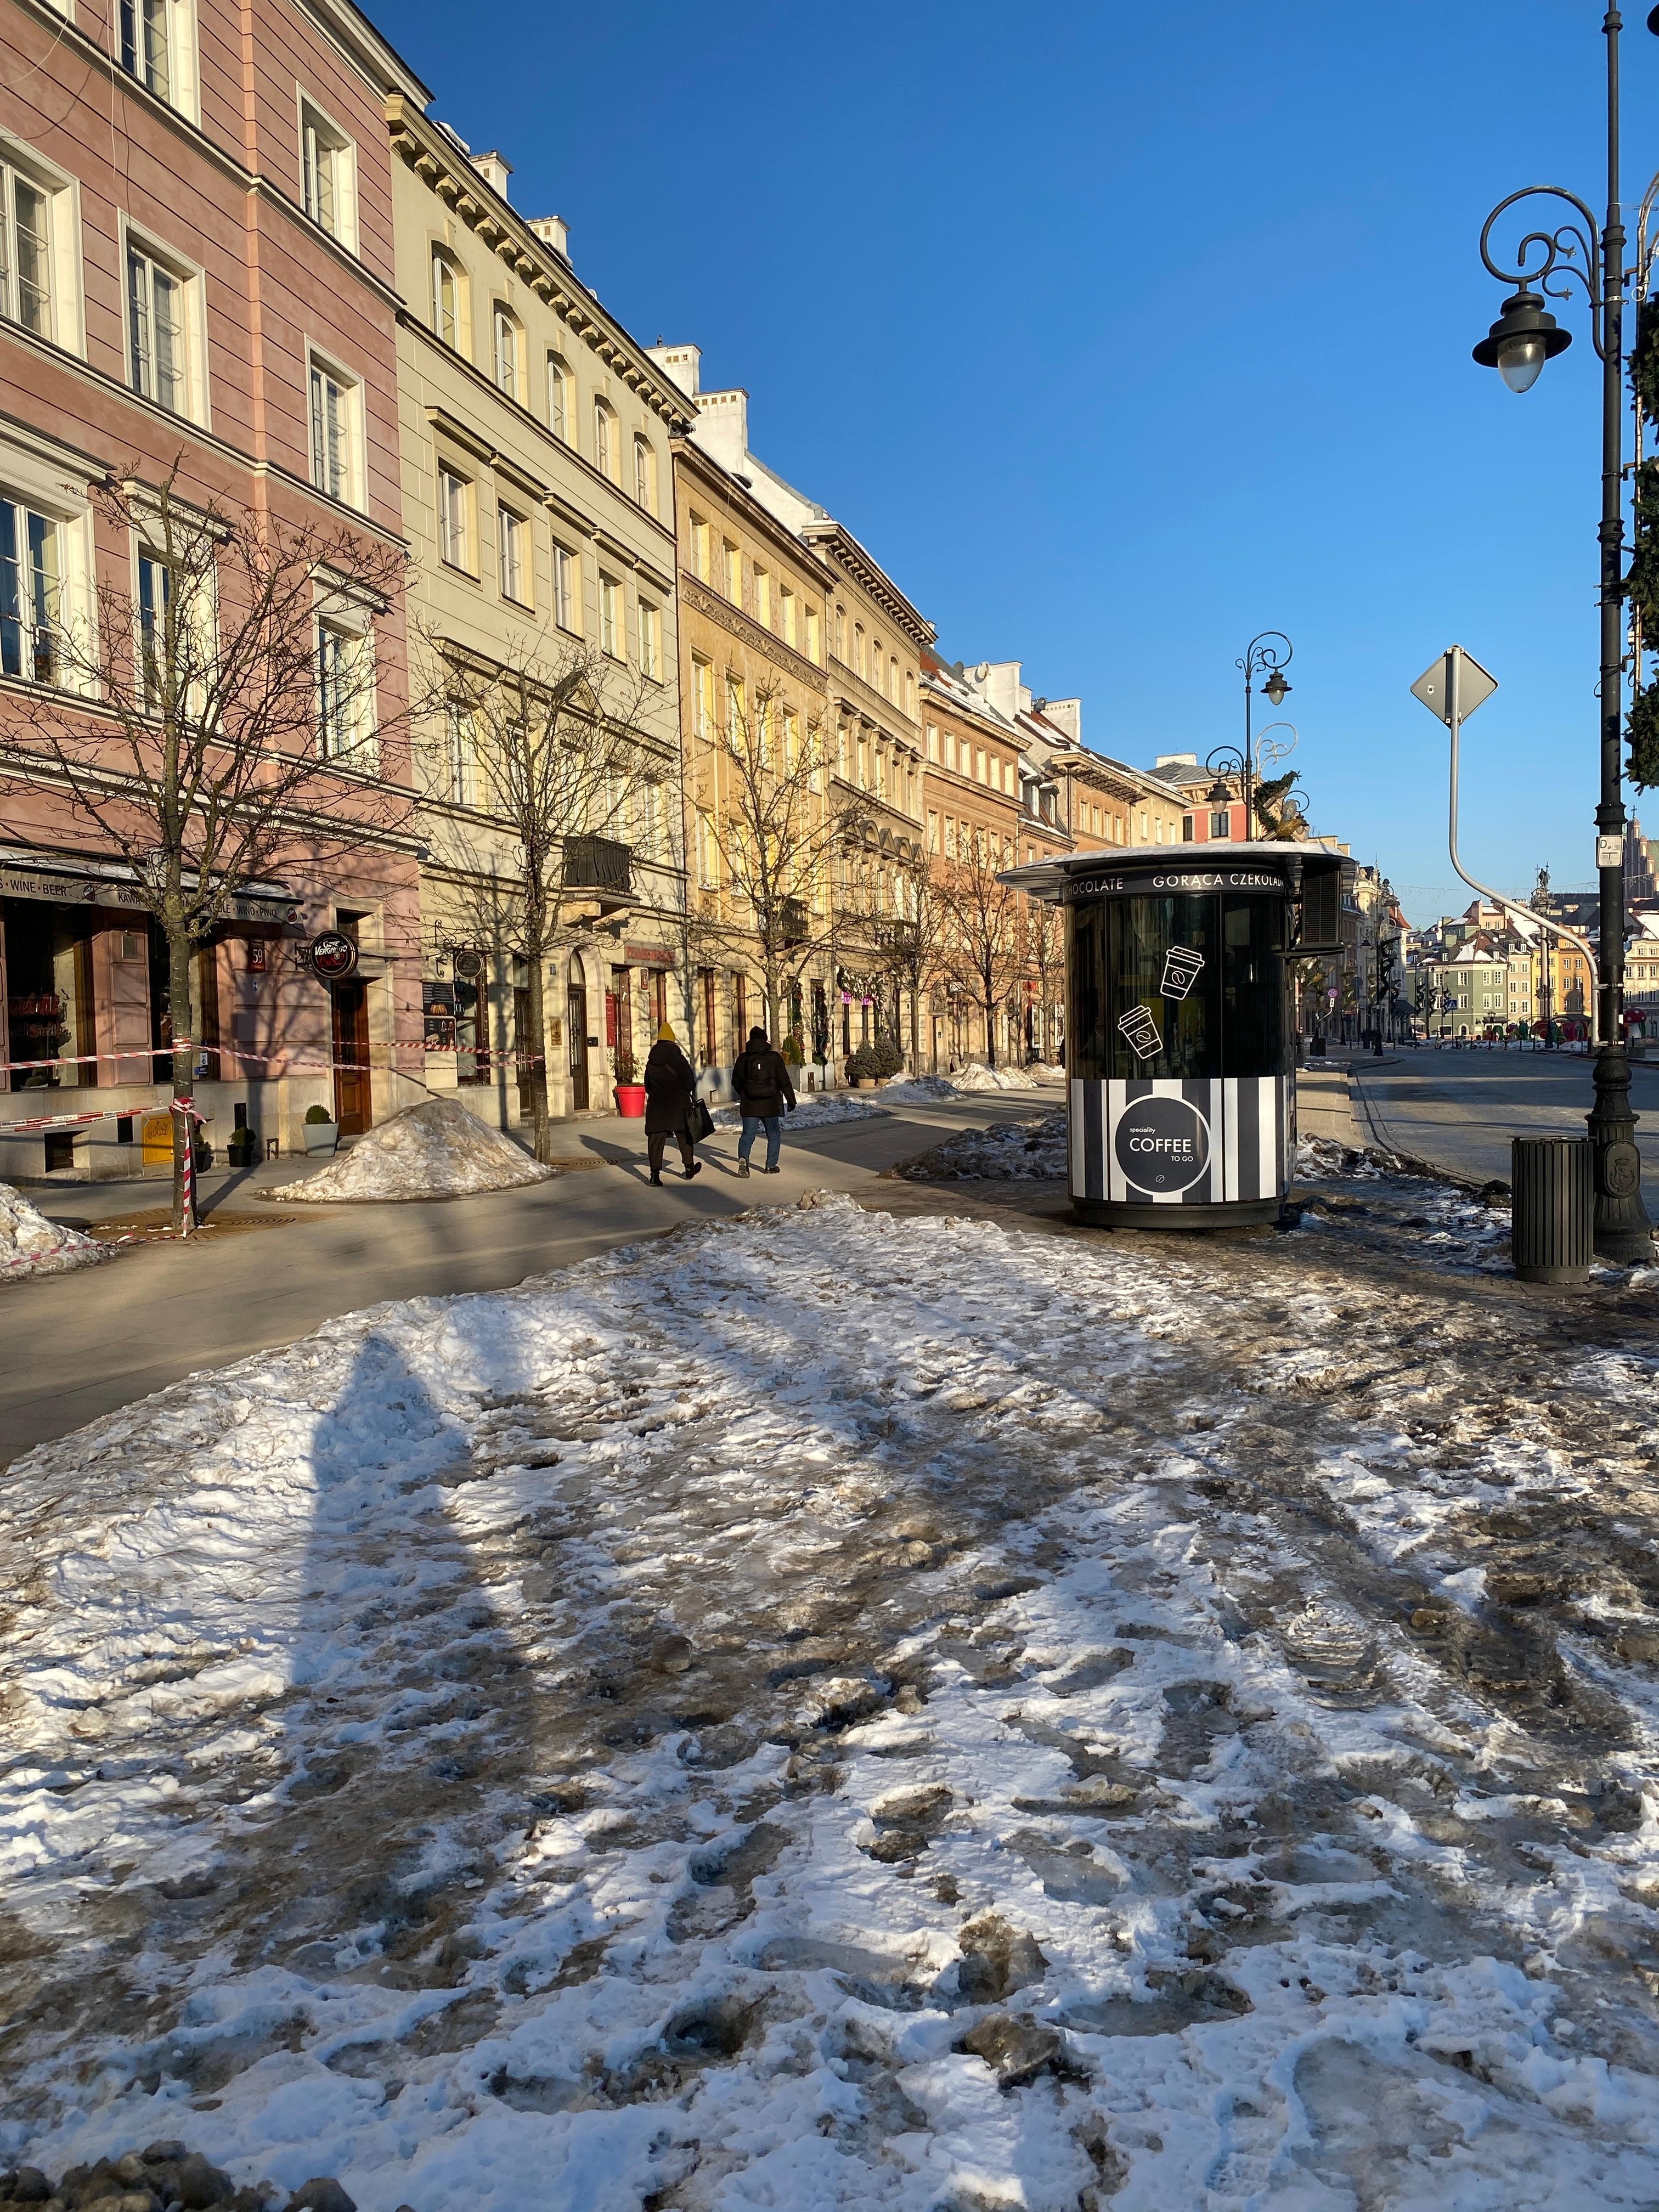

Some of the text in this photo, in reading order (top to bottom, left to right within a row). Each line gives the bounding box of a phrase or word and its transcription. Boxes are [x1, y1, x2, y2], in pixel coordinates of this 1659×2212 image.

[10, 879, 36, 893] WINE
[43, 883, 67, 897] BEER
[1065, 878, 1123, 896] CHOCOLATE
[1153, 873, 1284, 889] GORĄCA CZEKOLADA
[118, 892, 141, 905] KAWA
[236, 905, 255, 916] WINO
[259, 908, 277, 918] PIWO
[253, 949, 263, 963] 59
[1130, 1126, 1156, 1135] speciality
[1130, 1137, 1191, 1152] COFFEE
